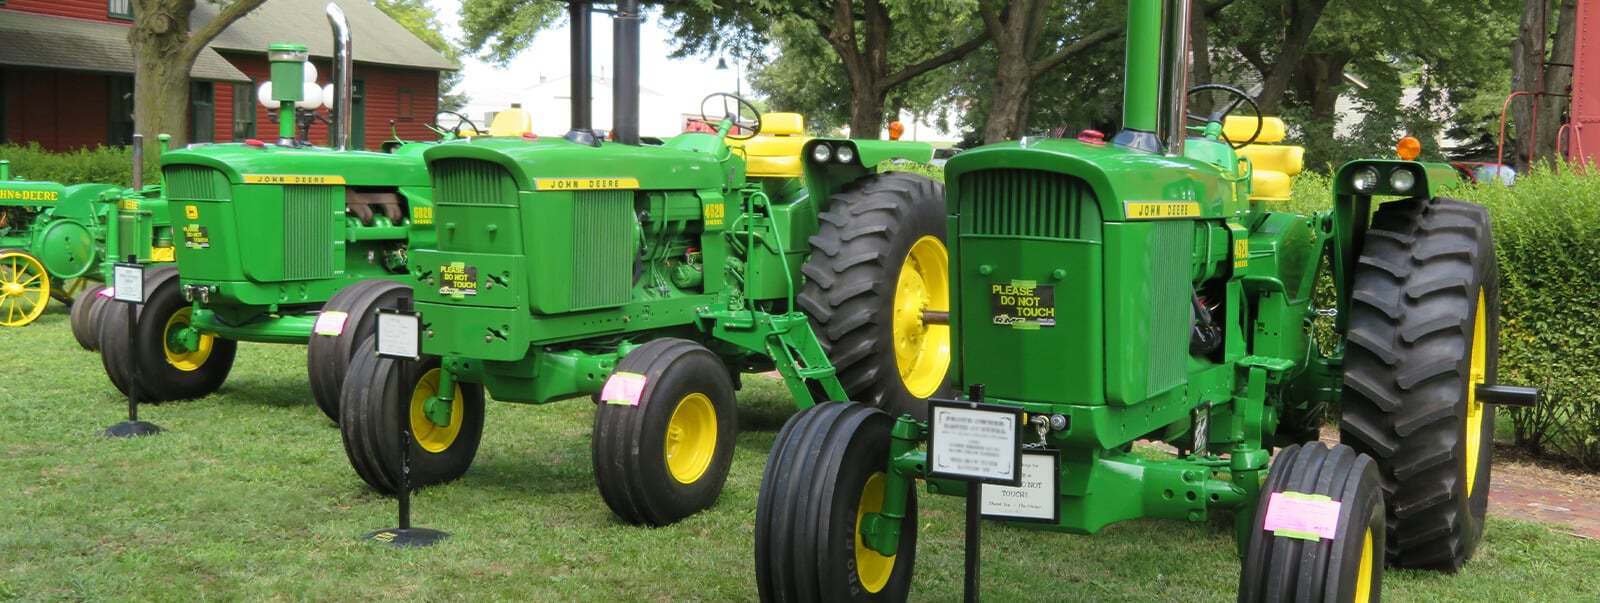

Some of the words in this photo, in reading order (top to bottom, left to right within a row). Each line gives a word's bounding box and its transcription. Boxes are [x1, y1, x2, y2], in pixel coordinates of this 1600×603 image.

[551, 181, 579, 189] JOHN
[589, 180, 620, 188] DEERE
[22, 190, 58, 201] DEERE
[704, 203, 725, 219] 4520
[1138, 204, 1161, 217] JOHN
[1167, 204, 1188, 216] DEERE
[1233, 239, 1249, 259] 4520
[440, 265, 465, 274] PLEASE
[453, 281, 477, 289] TOUCH
[992, 284, 1034, 296] PLEASE
[1000, 295, 1015, 306] DO
[1017, 296, 1041, 307] NOT
[1016, 307, 1055, 317] TOUCH
[1027, 481, 1042, 489] NOT
